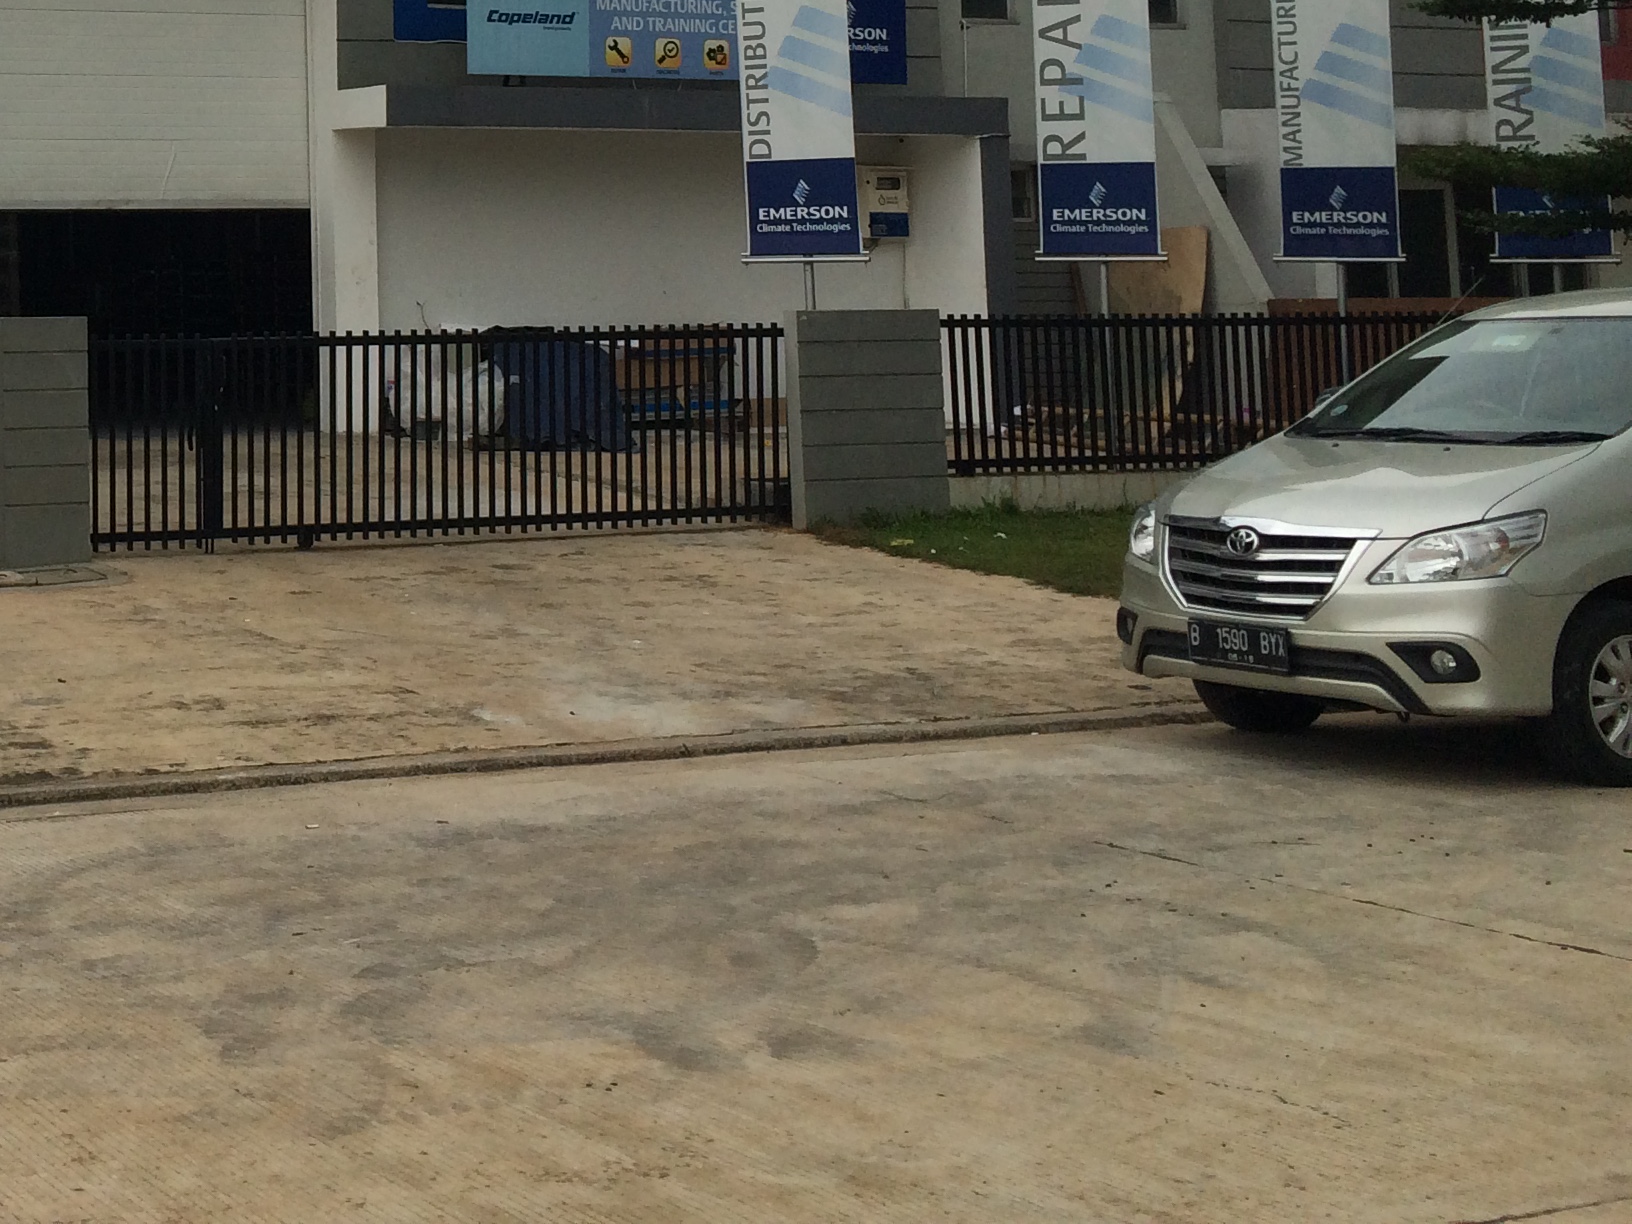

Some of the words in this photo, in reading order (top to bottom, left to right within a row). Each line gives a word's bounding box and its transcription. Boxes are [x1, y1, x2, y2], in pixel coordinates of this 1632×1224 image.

[486, 9, 576, 26] Copeland
[610, 16, 644, 32] AND
[646, 17, 717, 34] TRAINING
[848, 27, 887, 41] RSON
[758, 205, 849, 221] EMERSON
[1052, 208, 1147, 221] EMERSON
[1292, 210, 1388, 224] EMERSON
[756, 223, 791, 233] Climate
[792, 222, 852, 234] Technologies
[1050, 223, 1086, 233] Climate
[1088, 223, 1149, 235] Technologies
[1290, 225, 1326, 235] Climate
[1328, 226, 1390, 237] Technologies
[1190, 623, 1200, 646] B
[1216, 627, 1249, 651] 1590
